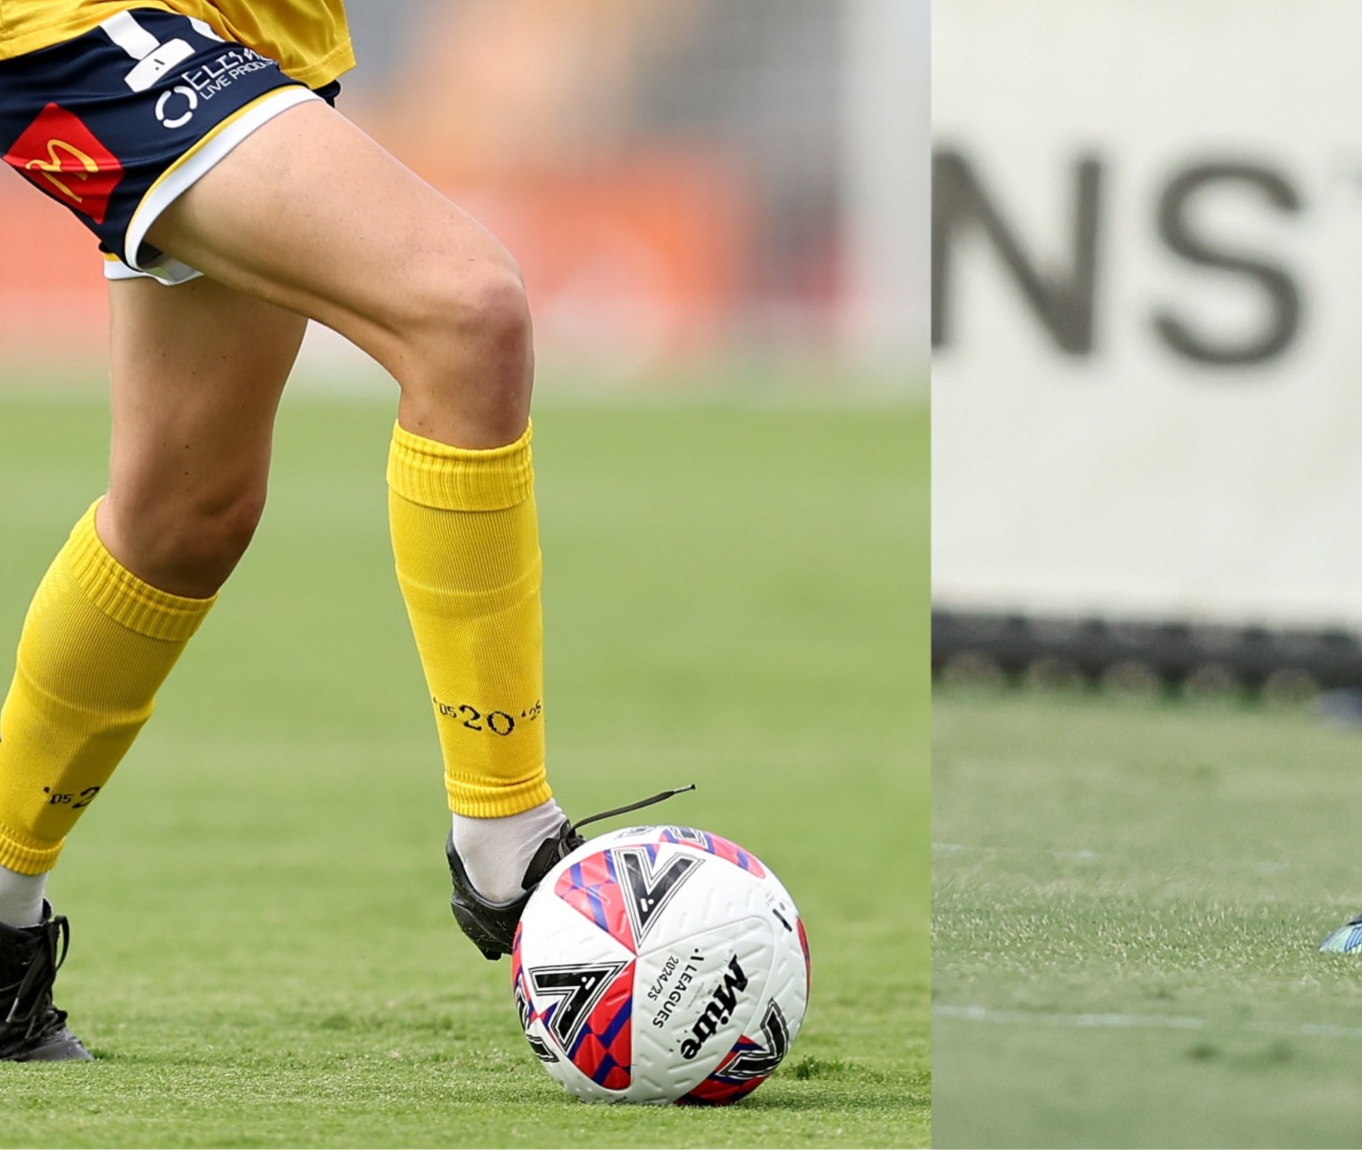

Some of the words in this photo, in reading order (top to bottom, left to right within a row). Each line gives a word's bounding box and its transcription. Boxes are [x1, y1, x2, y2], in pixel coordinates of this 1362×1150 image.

[200, 75, 232, 100] LIVE
[459, 704, 515, 736] 20
[647, 955, 679, 1001] 2024/25
[652, 964, 698, 1028] LEAGUES
[680, 954, 749, 1060] Mitre
